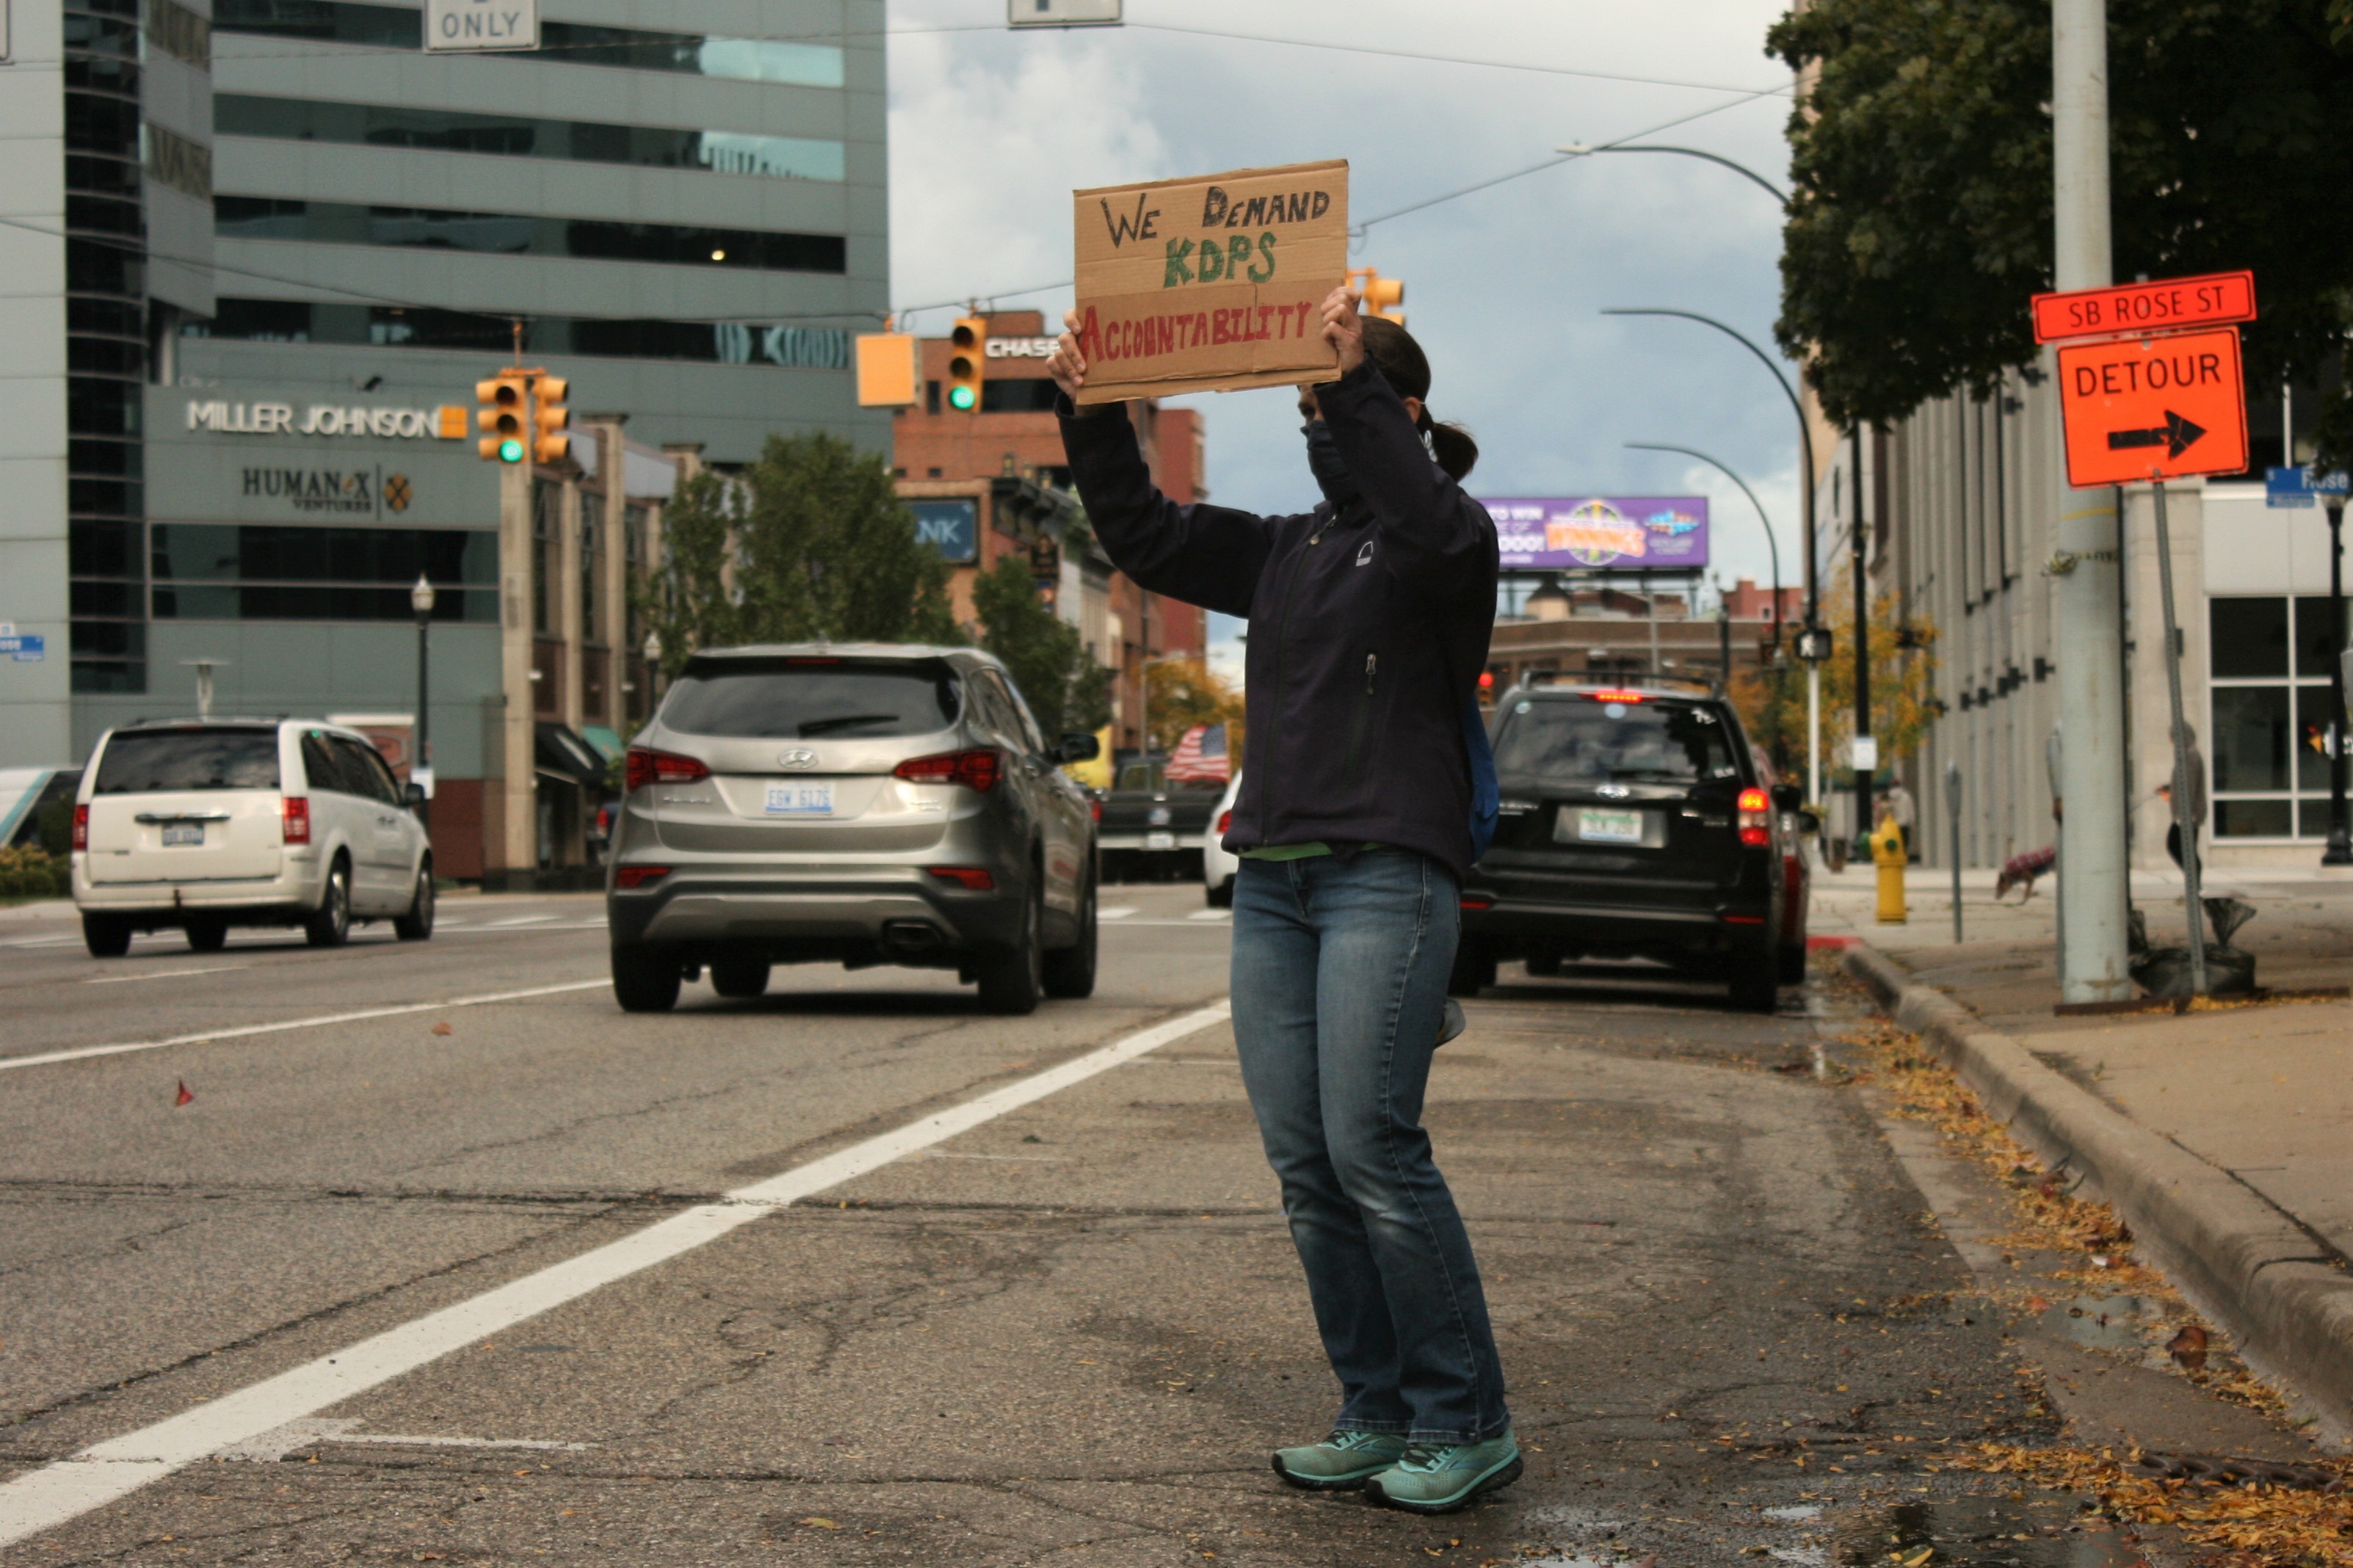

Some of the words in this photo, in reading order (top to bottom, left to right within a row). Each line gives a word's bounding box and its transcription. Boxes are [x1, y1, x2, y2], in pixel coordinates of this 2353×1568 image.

[442, 12, 520, 38] ONLY
[1163, 231, 1277, 289] KDPS
[2068, 300, 2102, 328] SB
[2114, 291, 2184, 323] ROSE
[2197, 286, 2225, 313] ST
[1078, 301, 1313, 363] ACCOUNTABILITY
[2075, 353, 2222, 398] DETOUR
[187, 400, 293, 434] MILLER
[299, 405, 442, 440] JOHNSON
